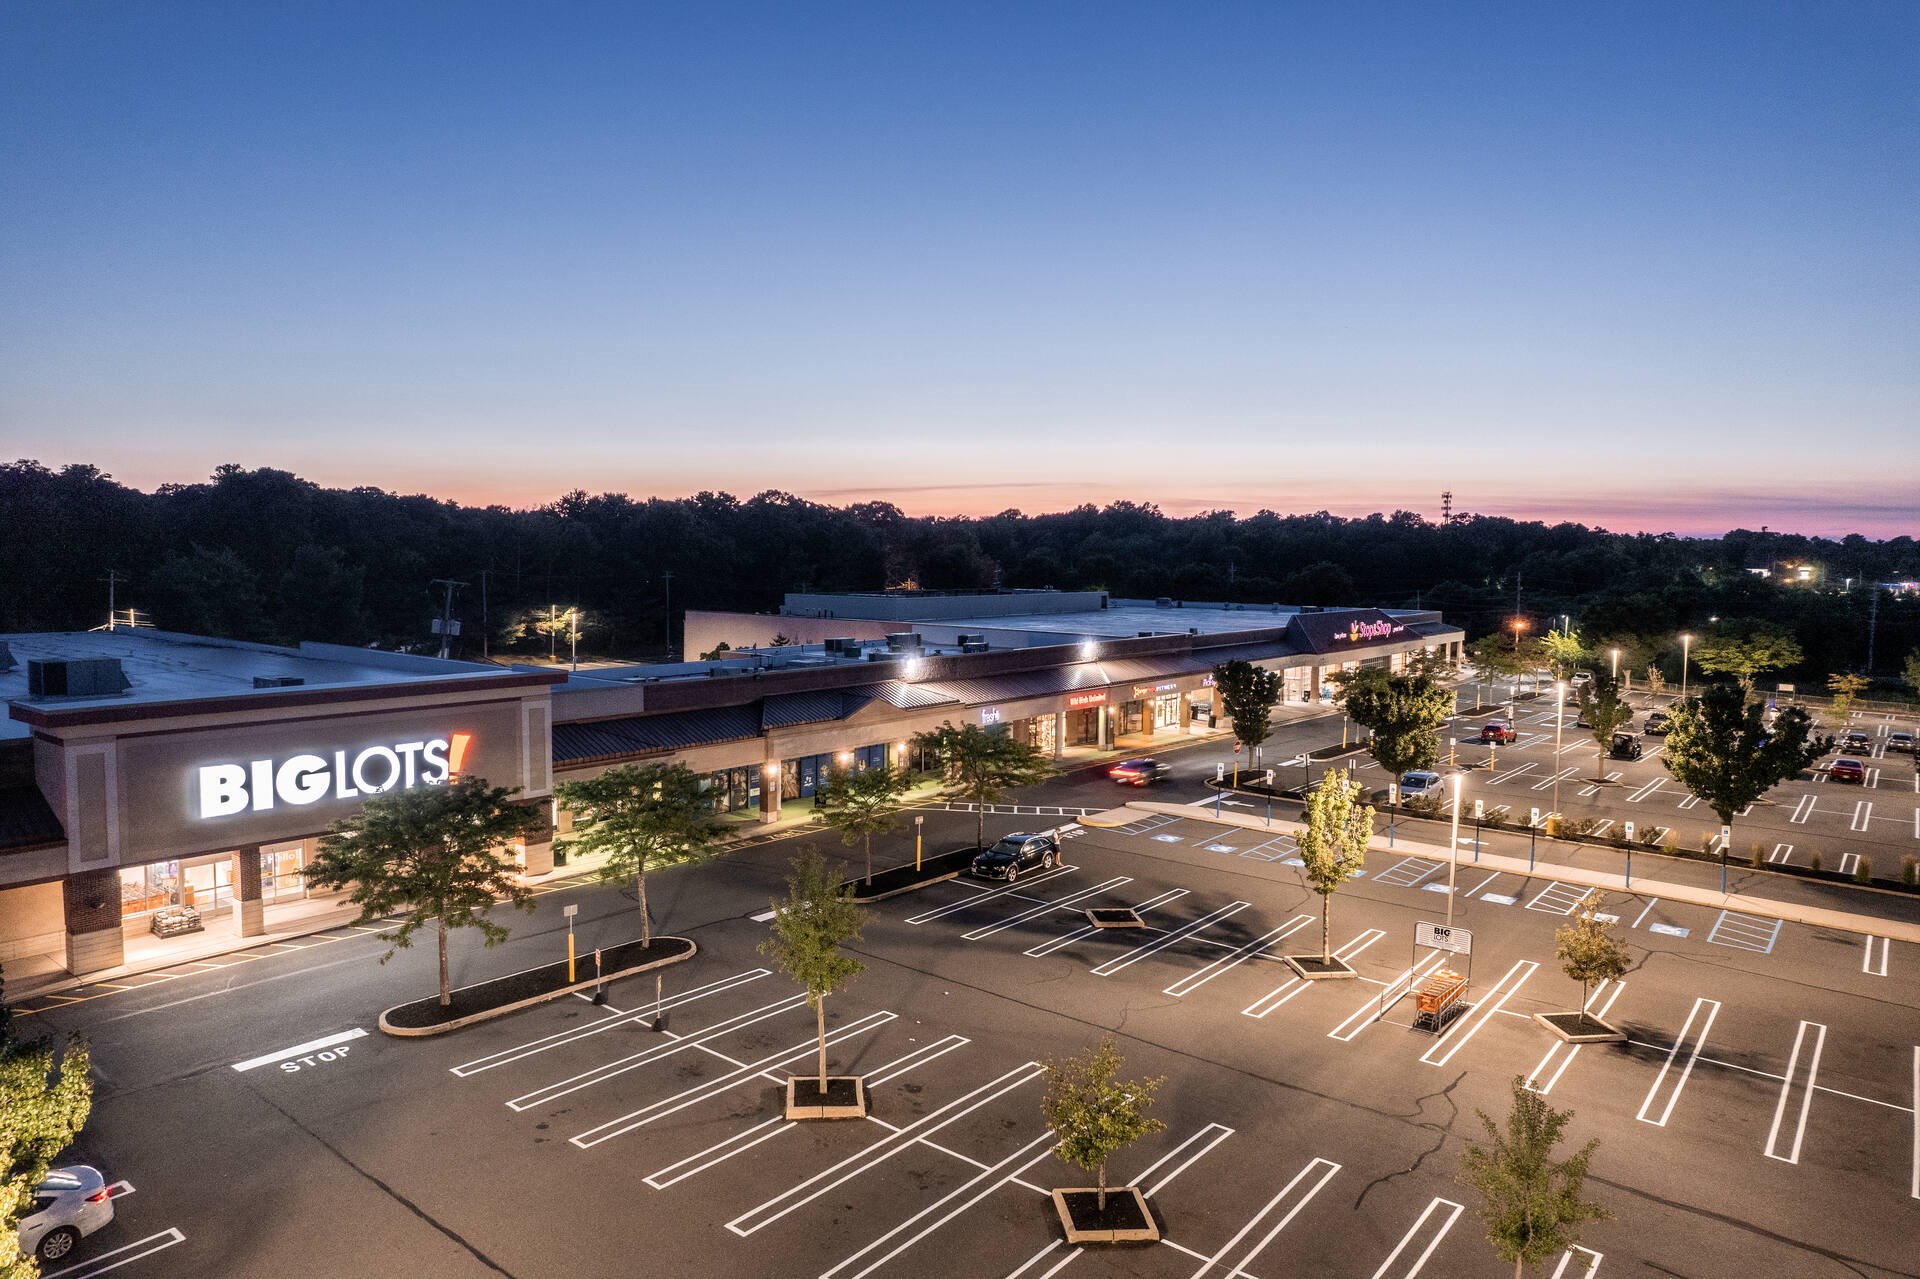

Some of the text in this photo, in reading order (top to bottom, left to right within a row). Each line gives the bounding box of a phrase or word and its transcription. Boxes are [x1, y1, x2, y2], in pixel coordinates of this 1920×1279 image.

[200, 754, 331, 819] BIG
[1434, 927, 1451, 937] BIG
[280, 1046, 350, 1073] STOP
